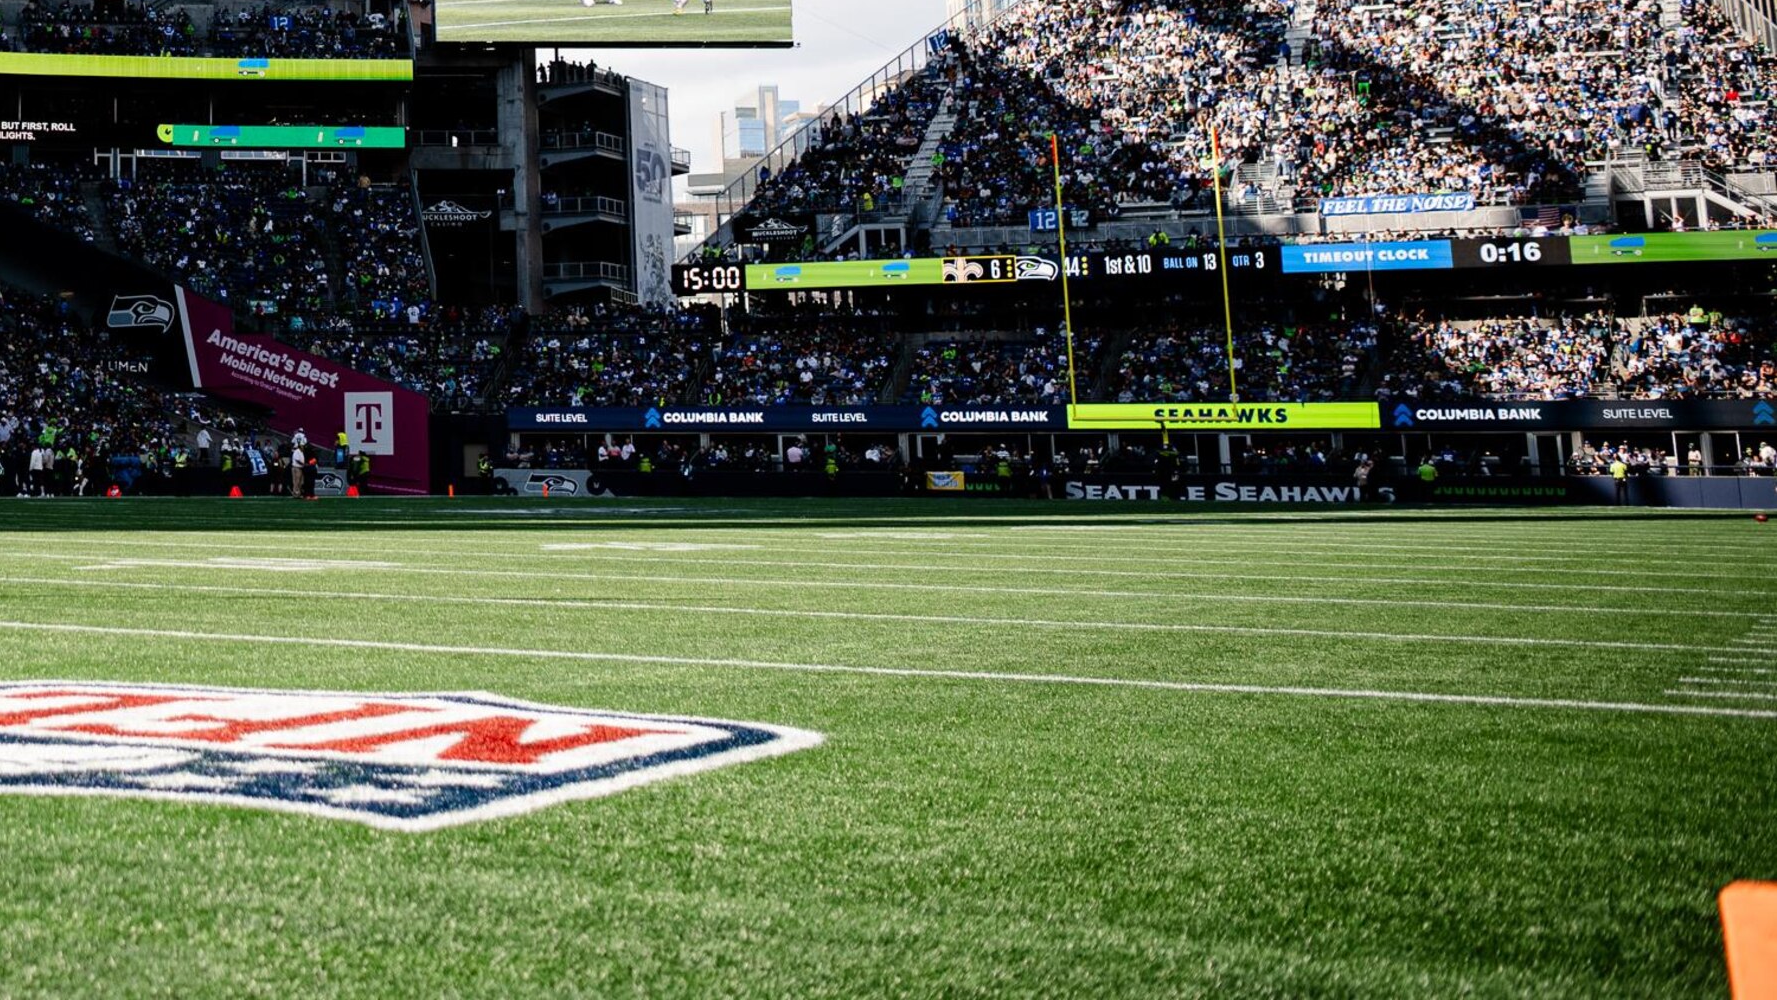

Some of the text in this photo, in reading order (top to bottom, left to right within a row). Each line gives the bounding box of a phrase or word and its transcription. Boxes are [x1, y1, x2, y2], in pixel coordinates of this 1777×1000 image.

[274, 16, 288, 30] 12
[1, 121, 20, 130] BUT
[22, 122, 49, 132] FIRST,
[51, 122, 76, 132] ROLL
[1323, 199, 1368, 215] FEEL
[1371, 196, 1408, 212] THE
[1036, 211, 1056, 230] 12
[1233, 252, 1264, 269] QTR 3
[1304, 247, 1429, 264] TIMEOUT CLOCK
[1481, 242, 1541, 262] 0:16
[991, 259, 1000, 279] 6
[1062, 257, 1080, 277] 44
[1104, 255, 1152, 275] 1st & 10
[1164, 253, 1217, 271] BALL ON 13
[683, 266, 741, 290] 15:00
[207, 328, 296, 373] America's
[296, 360, 339, 389] Best
[220, 352, 262, 378] Mobile
[262, 370, 318, 398] Network
[536, 412, 588, 424] SUITE LEVEL
[663, 411, 764, 424] COLUMBIA BANK
[812, 412, 867, 423] SUITE LEVEL
[940, 410, 1048, 423] COLUMBIA BANK
[1154, 408, 1288, 424] SEAHAWKS
[1416, 408, 1541, 421] COLUMBIA BANK
[1603, 408, 1673, 419] SUITE LEVEL
[1066, 481, 1396, 503] SEATTE SEAHAWS
